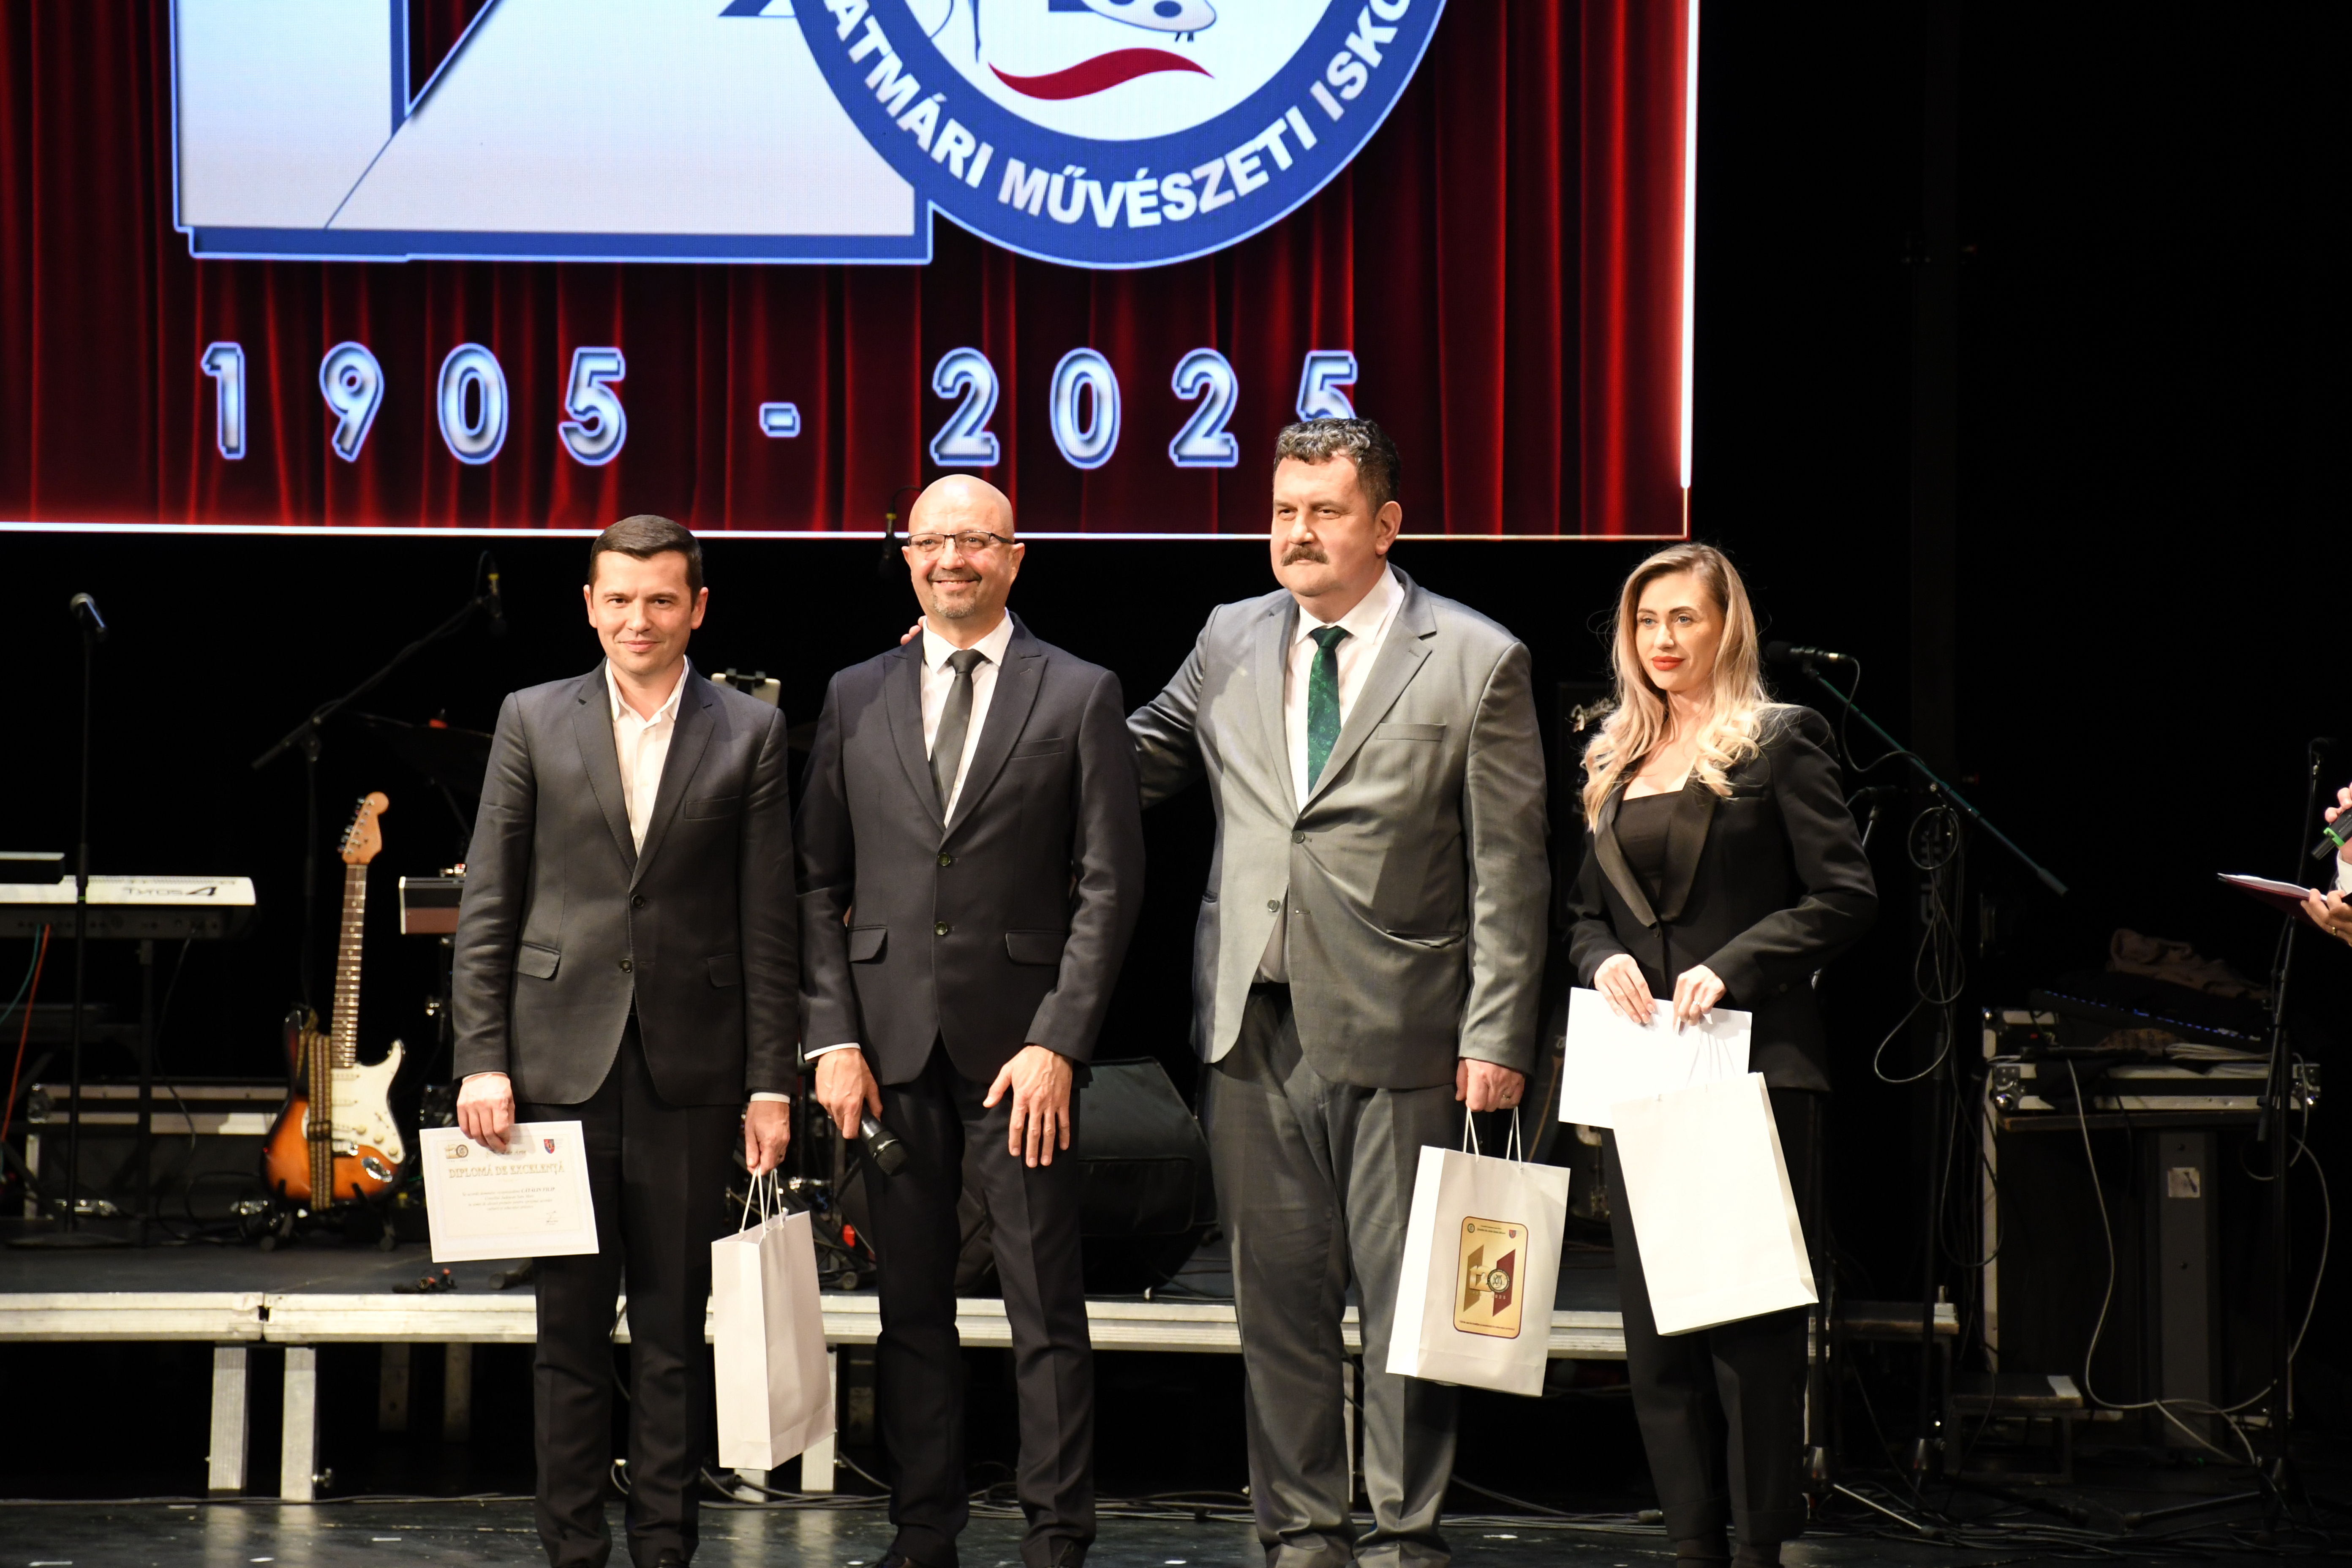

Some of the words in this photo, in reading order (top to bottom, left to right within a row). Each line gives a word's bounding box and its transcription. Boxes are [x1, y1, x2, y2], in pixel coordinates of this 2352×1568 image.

[999, 107, 1316, 228] MŰVÉSZETI
[200, 341, 627, 466] 1905
[759, 402, 801, 438] -
[929, 347, 1358, 469] 2025
[495, 1165, 507, 1175] DE
